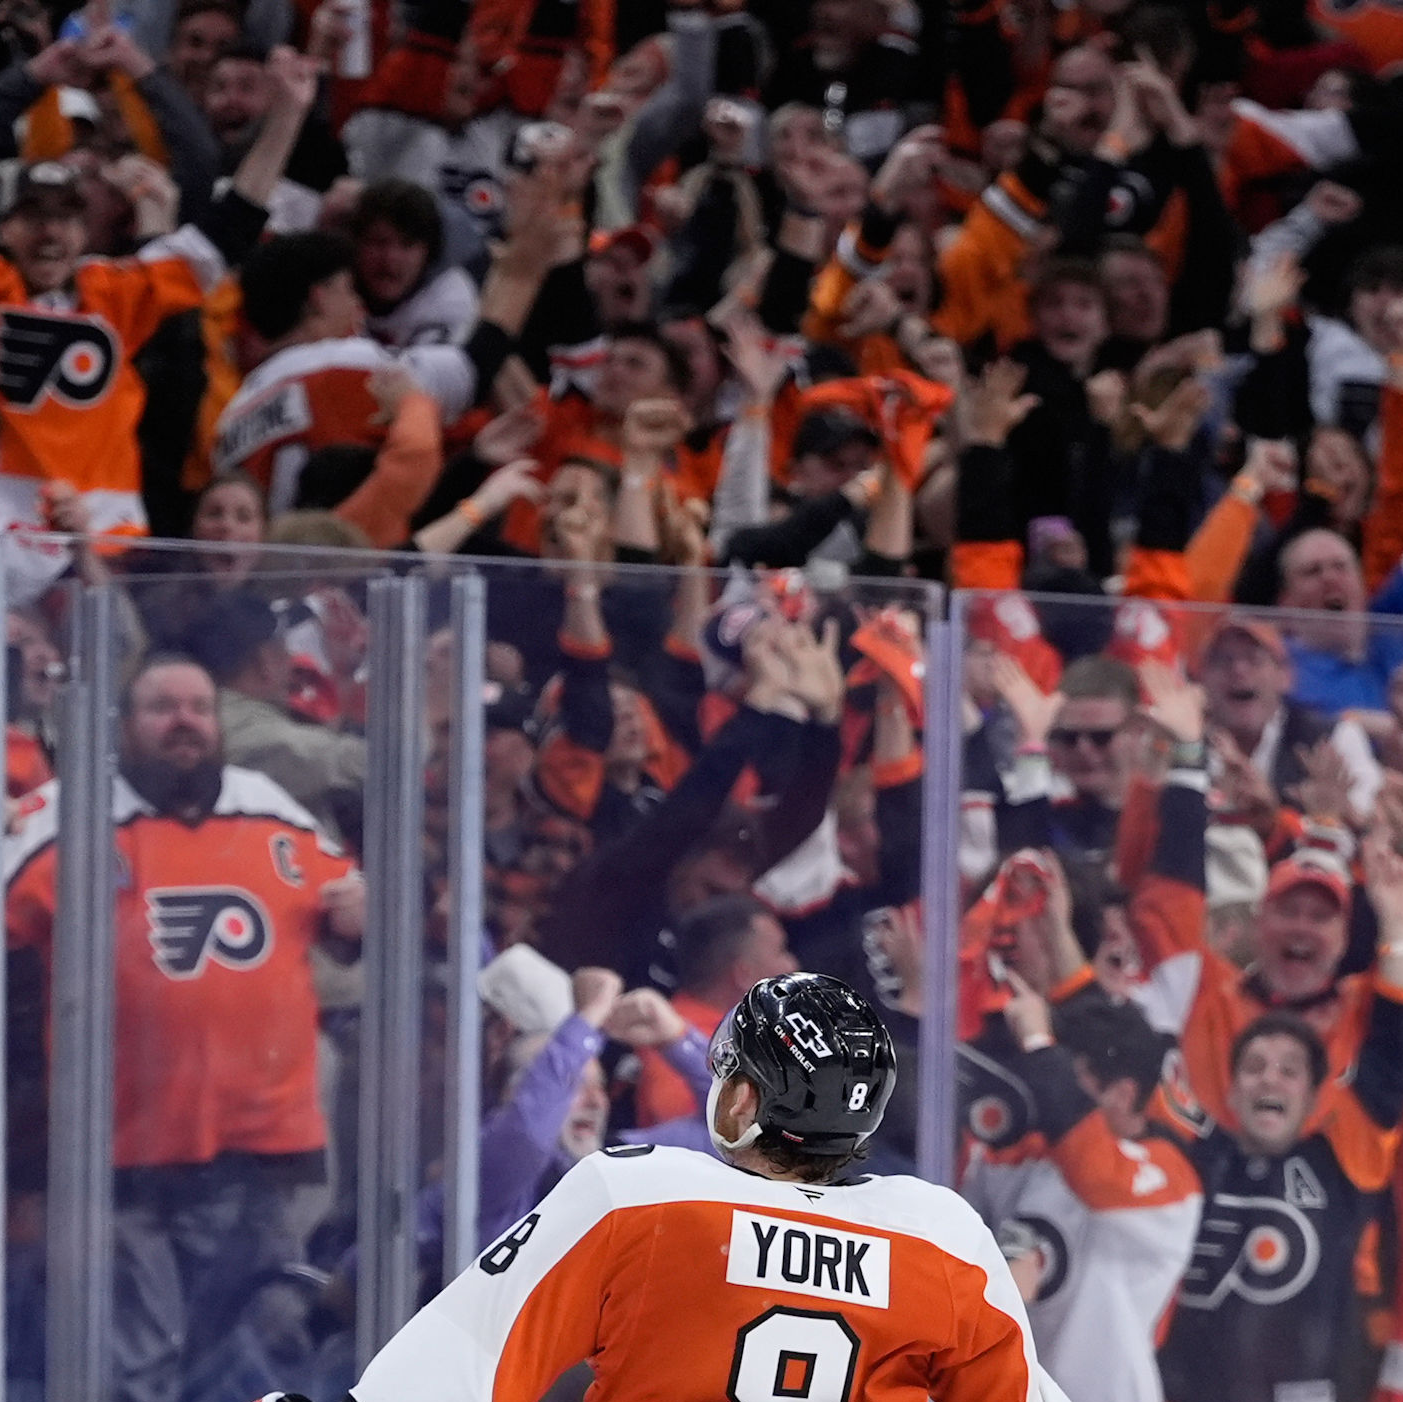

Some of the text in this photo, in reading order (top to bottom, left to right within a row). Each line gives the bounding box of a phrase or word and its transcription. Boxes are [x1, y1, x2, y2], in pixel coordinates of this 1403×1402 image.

[773, 1024, 817, 1074] CHEVROLET
[848, 1082, 869, 1111] 8
[479, 1212, 541, 1276] 8
[751, 1221, 871, 1297] YORK
